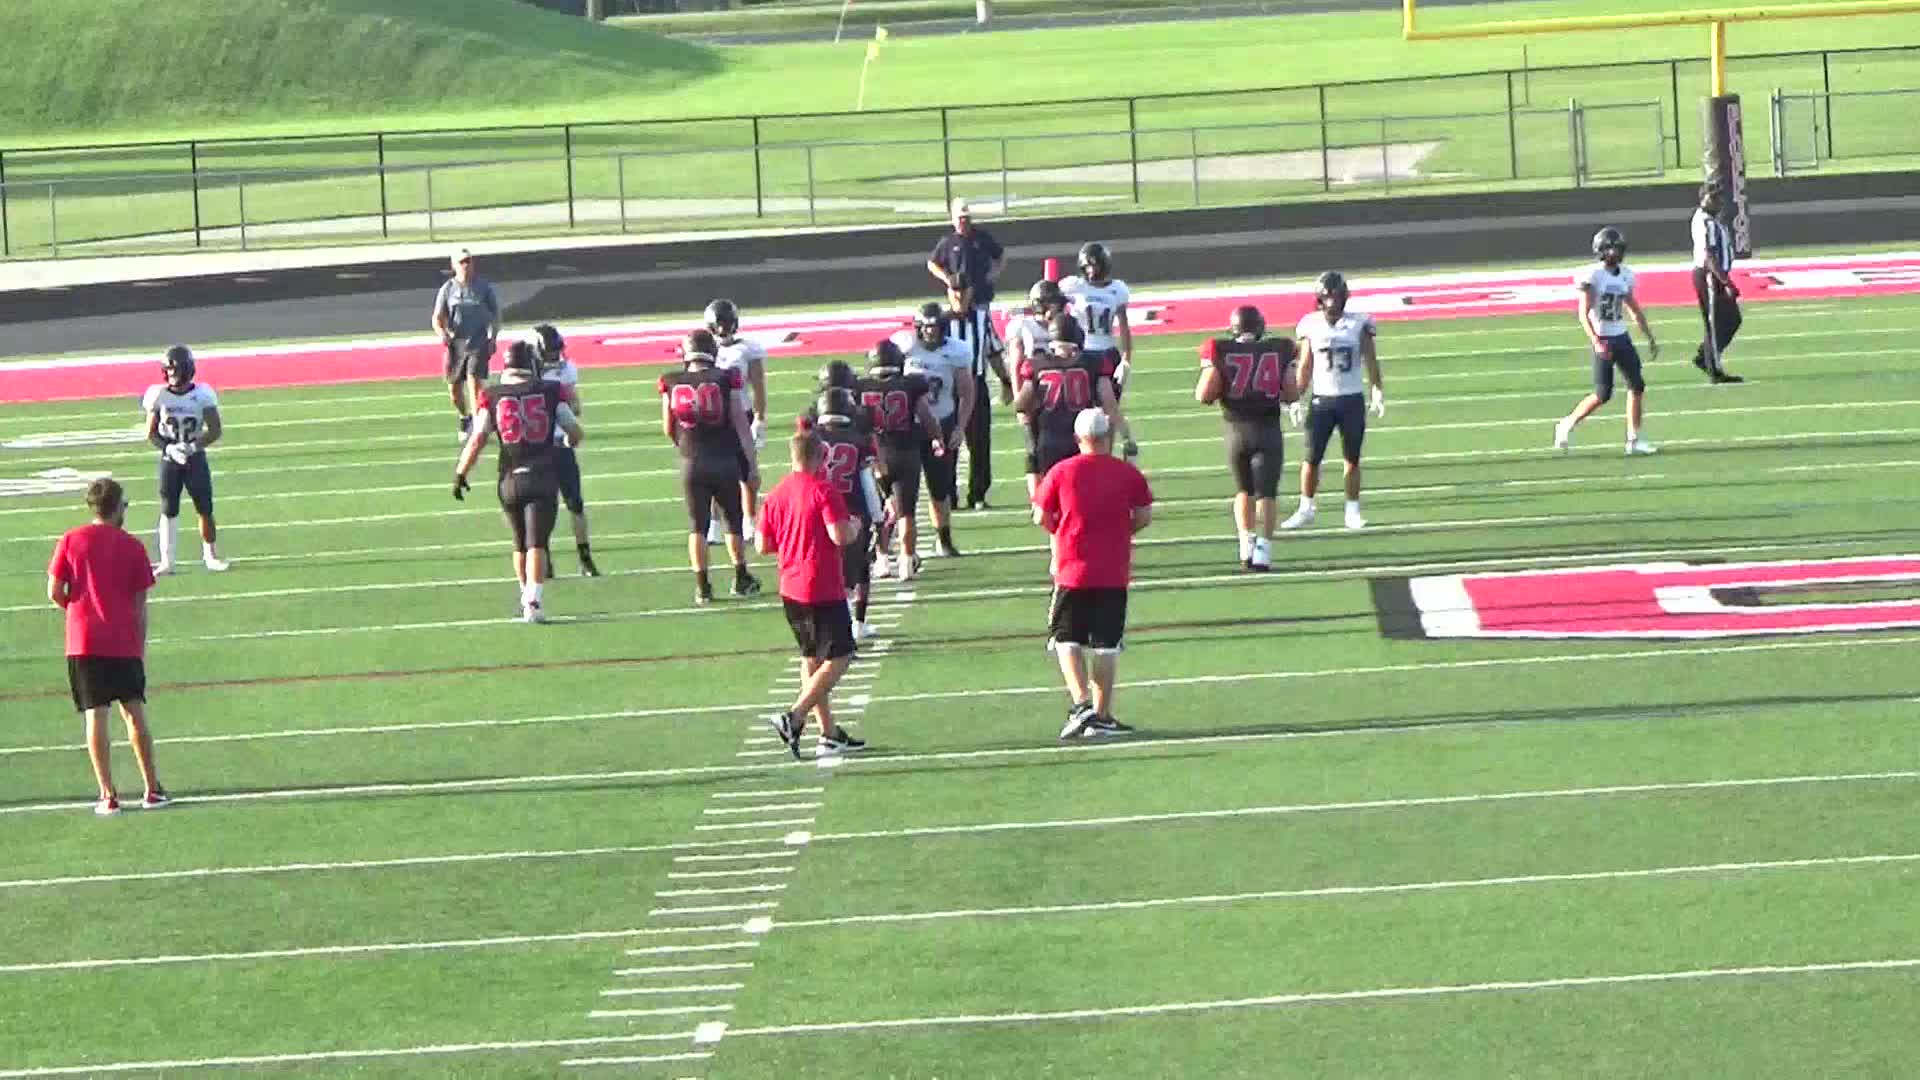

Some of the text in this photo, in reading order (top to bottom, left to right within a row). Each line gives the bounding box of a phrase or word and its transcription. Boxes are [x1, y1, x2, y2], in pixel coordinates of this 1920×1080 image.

[1038, 368, 1091, 412] 70
[1225, 353, 1281, 398] 74
[496, 393, 549, 444] 65
